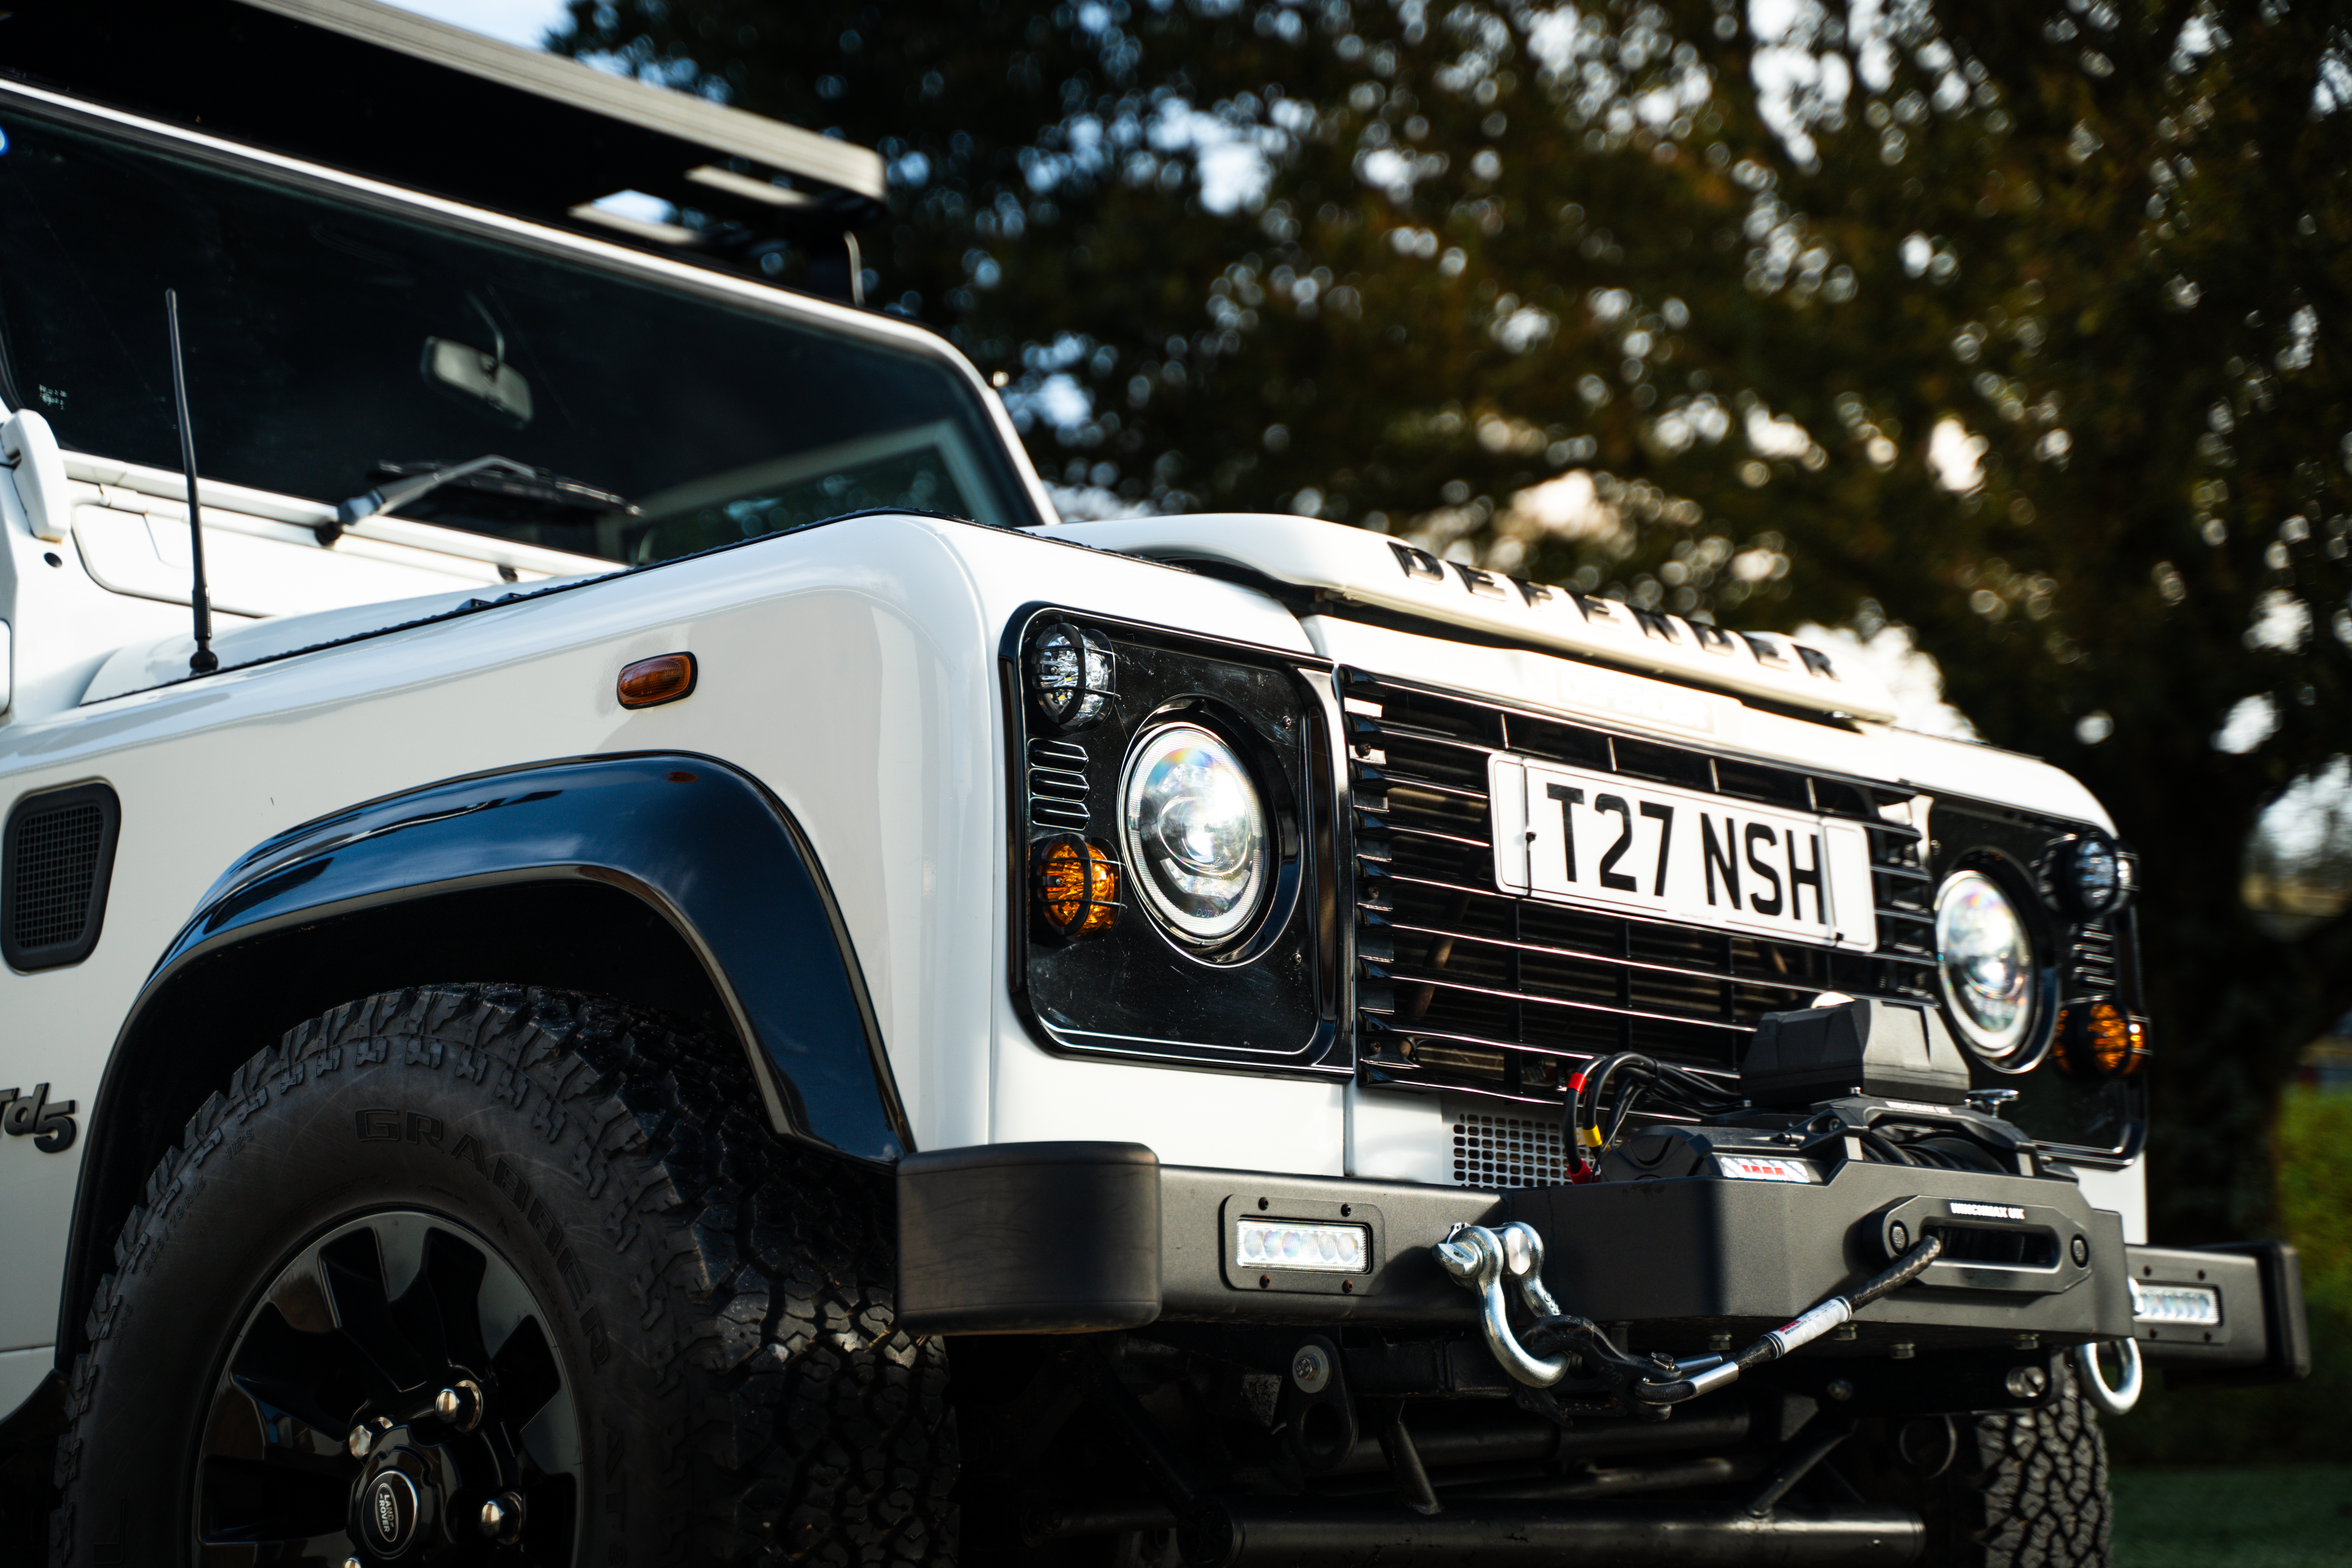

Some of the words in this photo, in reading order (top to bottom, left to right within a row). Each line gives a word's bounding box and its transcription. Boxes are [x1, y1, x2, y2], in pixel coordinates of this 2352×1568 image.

[1387, 541, 1842, 681] DEFENDER
[1562, 670, 1709, 729] DEFENDER
[1546, 782, 1674, 897] T27
[1701, 812, 1827, 924] NSH
[1196, 908, 1212, 918] DOT
[1950, 1203, 2008, 1218] WINCHMAX
[2008, 1207, 2026, 1220] UK
[354, 1108, 609, 1374] GRABBER
[379, 1500, 390, 1532] ROVER
[384, 1495, 394, 1521] LAND
